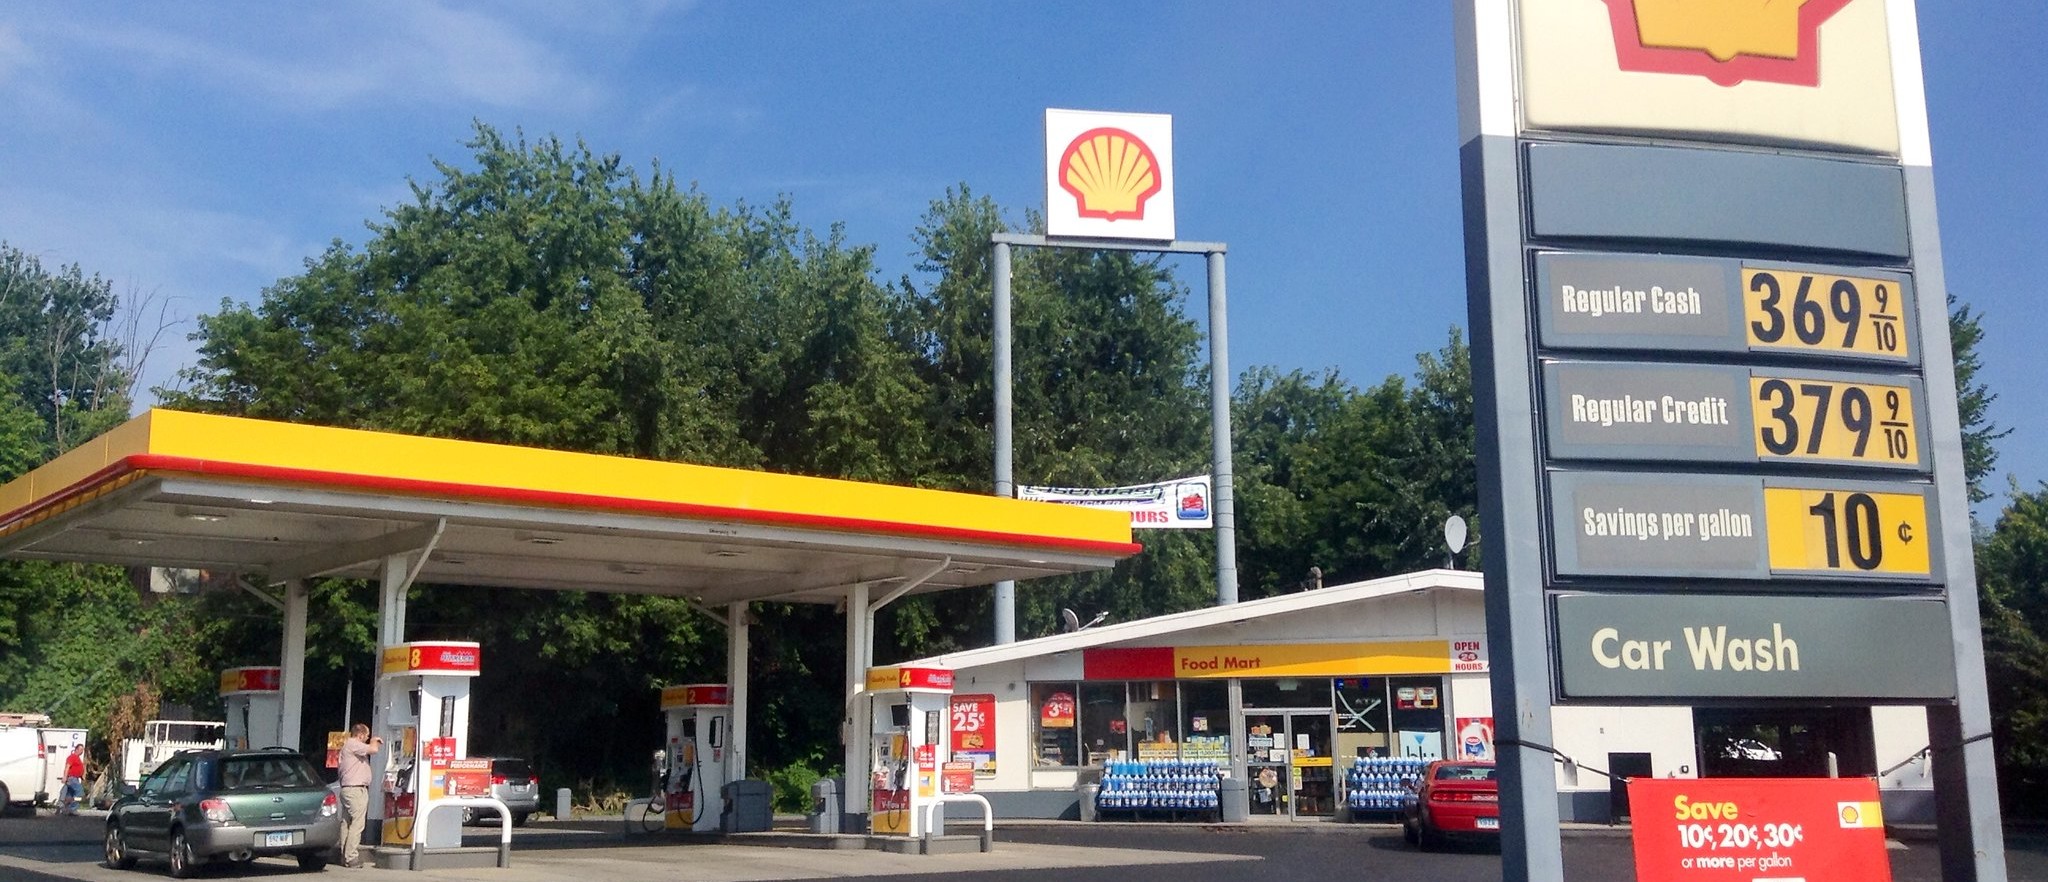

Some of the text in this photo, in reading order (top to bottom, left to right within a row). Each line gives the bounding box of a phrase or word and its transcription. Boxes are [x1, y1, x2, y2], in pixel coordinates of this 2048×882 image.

[1562, 285, 1701, 317] Regular Cash
[1750, 272, 1861, 349] 369
[1571, 394, 1729, 427] Regular Credit
[1759, 379, 1872, 457] 379
[1584, 508, 1752, 541] Savings per gallon
[1809, 492, 1883, 570] 10
[1454, 641, 1480, 651] OPEN
[1591, 623, 1800, 672] Car Wash
[411, 649, 421, 668] 8
[1181, 656, 1261, 670] Food Mart
[1455, 663, 1483, 671] HOURS
[241, 672, 247, 688] 6
[901, 670, 912, 685] 4
[689, 690, 696, 703] 2
[953, 702, 979, 713] SAVE
[1674, 794, 1738, 821] Save
[1681, 852, 1792, 872] or more per gallon
